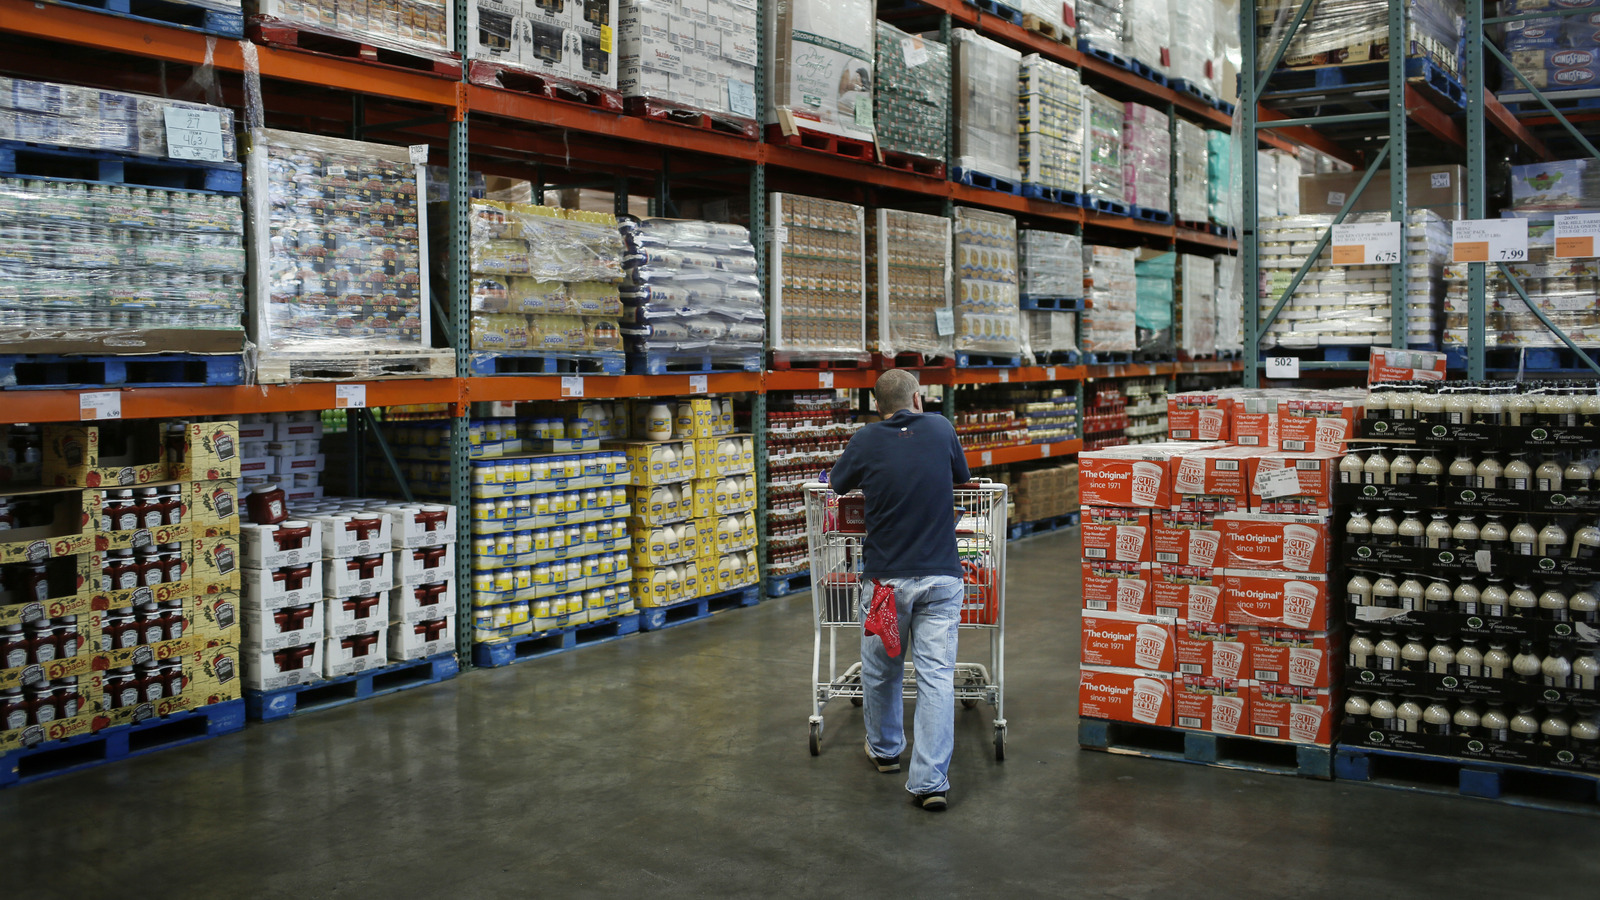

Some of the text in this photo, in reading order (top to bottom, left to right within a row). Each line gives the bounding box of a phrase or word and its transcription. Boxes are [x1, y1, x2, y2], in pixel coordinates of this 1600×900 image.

[489, 3, 508, 13] OLIVE
[510, 8, 521, 16] OIL
[525, 12, 571, 29] PURE OLIVE OIL
[574, 25, 589, 34] PURE
[1554, 53, 1590, 65] KINGSFORD
[1558, 70, 1592, 82] KINGSFORD
[187, 118, 200, 129] 27
[1376, 252, 1397, 262] 6.75
[1501, 250, 1524, 260] 7.99
[582, 302, 599, 310] Snapple
[483, 334, 504, 343] Snapple
[544, 336, 564, 344] Snapple
[1275, 358, 1292, 366] 502
[192, 424, 201, 436] 3
[89, 432, 98, 443] 3
[1081, 470, 1132, 481] “The Original”
[1137, 476, 1156, 487] CUP
[194, 482, 202, 494] 3
[93, 495, 101, 506] 3
[170, 526, 189, 540] pack
[1226, 533, 1282, 544] “The Original”
[71, 538, 92, 552] pack
[195, 539, 204, 550] 3
[1236, 544, 1254, 552] since
[1290, 540, 1311, 550] CUP
[91, 555, 100, 567] 3
[170, 584, 190, 597] pack
[1226, 588, 1282, 600] “The Original”
[66, 600, 86, 613] pack
[194, 596, 203, 606] 3
[1237, 601, 1254, 609] since
[1290, 597, 1311, 607] CUP
[91, 615, 100, 627] 3
[1084, 629, 1135, 641] “The Original”
[171, 642, 190, 656] pack
[1111, 642, 1124, 650] 1971
[1142, 639, 1160, 649] CUP
[194, 651, 202, 662] 3
[65, 660, 87, 674] pack
[91, 676, 102, 688] 3
[1084, 682, 1132, 695] “The Original”
[1090, 694, 1122, 704] since 1971
[1138, 692, 1158, 704] CUP
[172, 699, 191, 711] pack
[66, 721, 87, 734] pack
